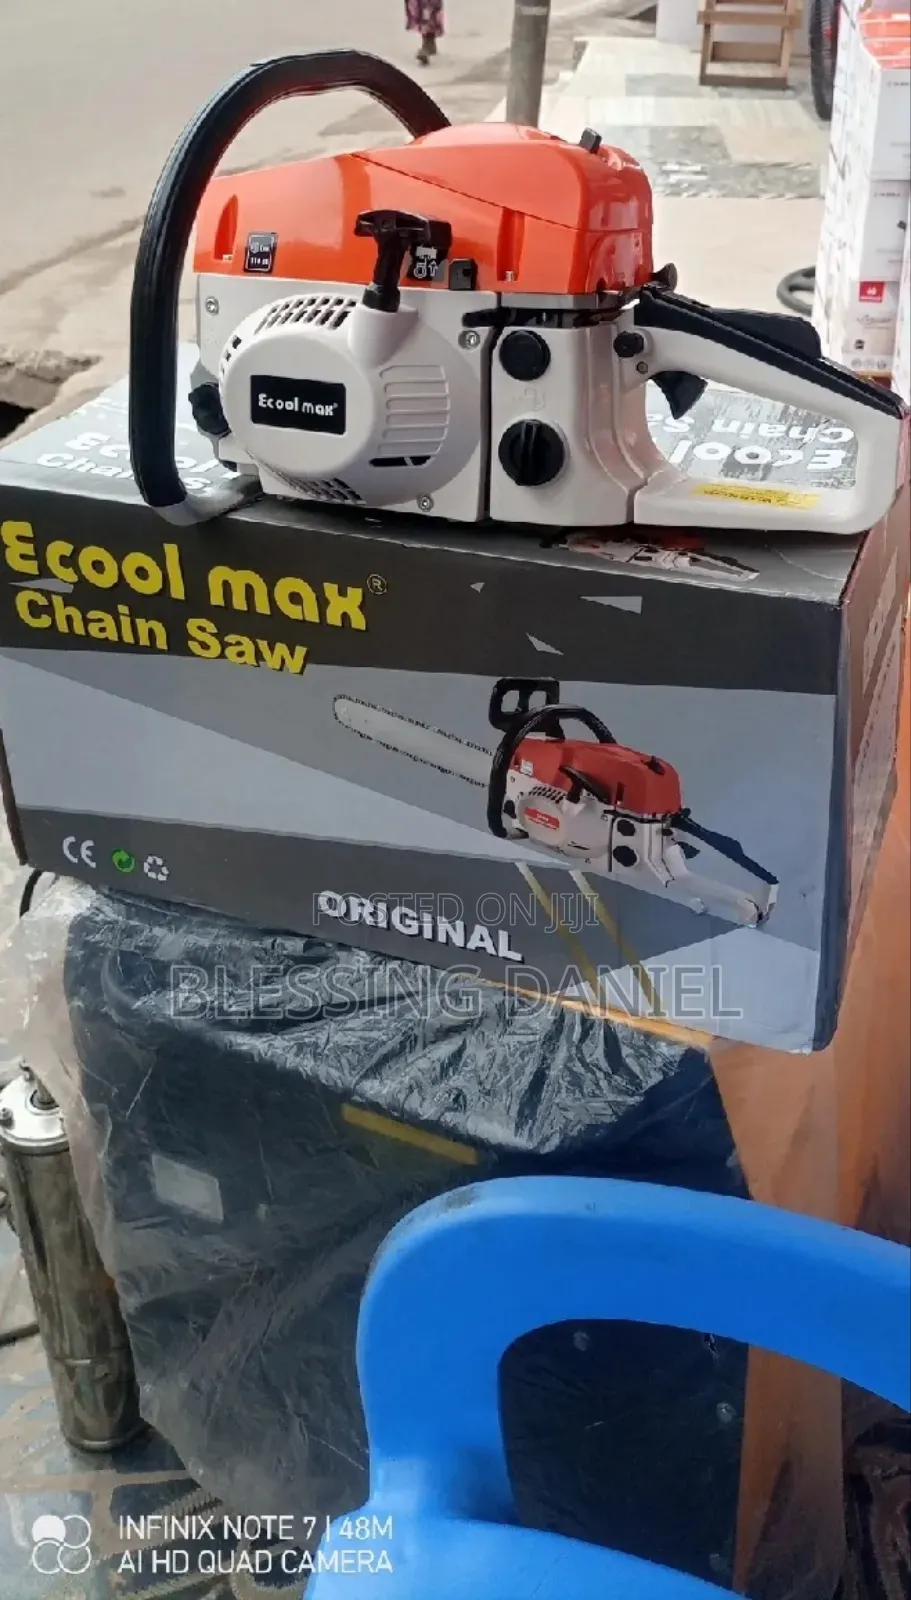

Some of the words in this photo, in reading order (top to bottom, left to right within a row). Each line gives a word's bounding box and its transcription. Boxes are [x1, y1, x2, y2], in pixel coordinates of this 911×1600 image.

[258, 393, 299, 412] Ecool
[302, 402, 334, 416] max
[64, 431, 219, 474] Ecol
[712, 420, 855, 444] Chain
[669, 440, 848, 470] Ecool
[1, 520, 186, 601] Ecool
[208, 565, 367, 631] max
[15, 590, 169, 651] Chain
[186, 618, 308, 676] Saw
[317, 889, 525, 964] ORIGINAL
